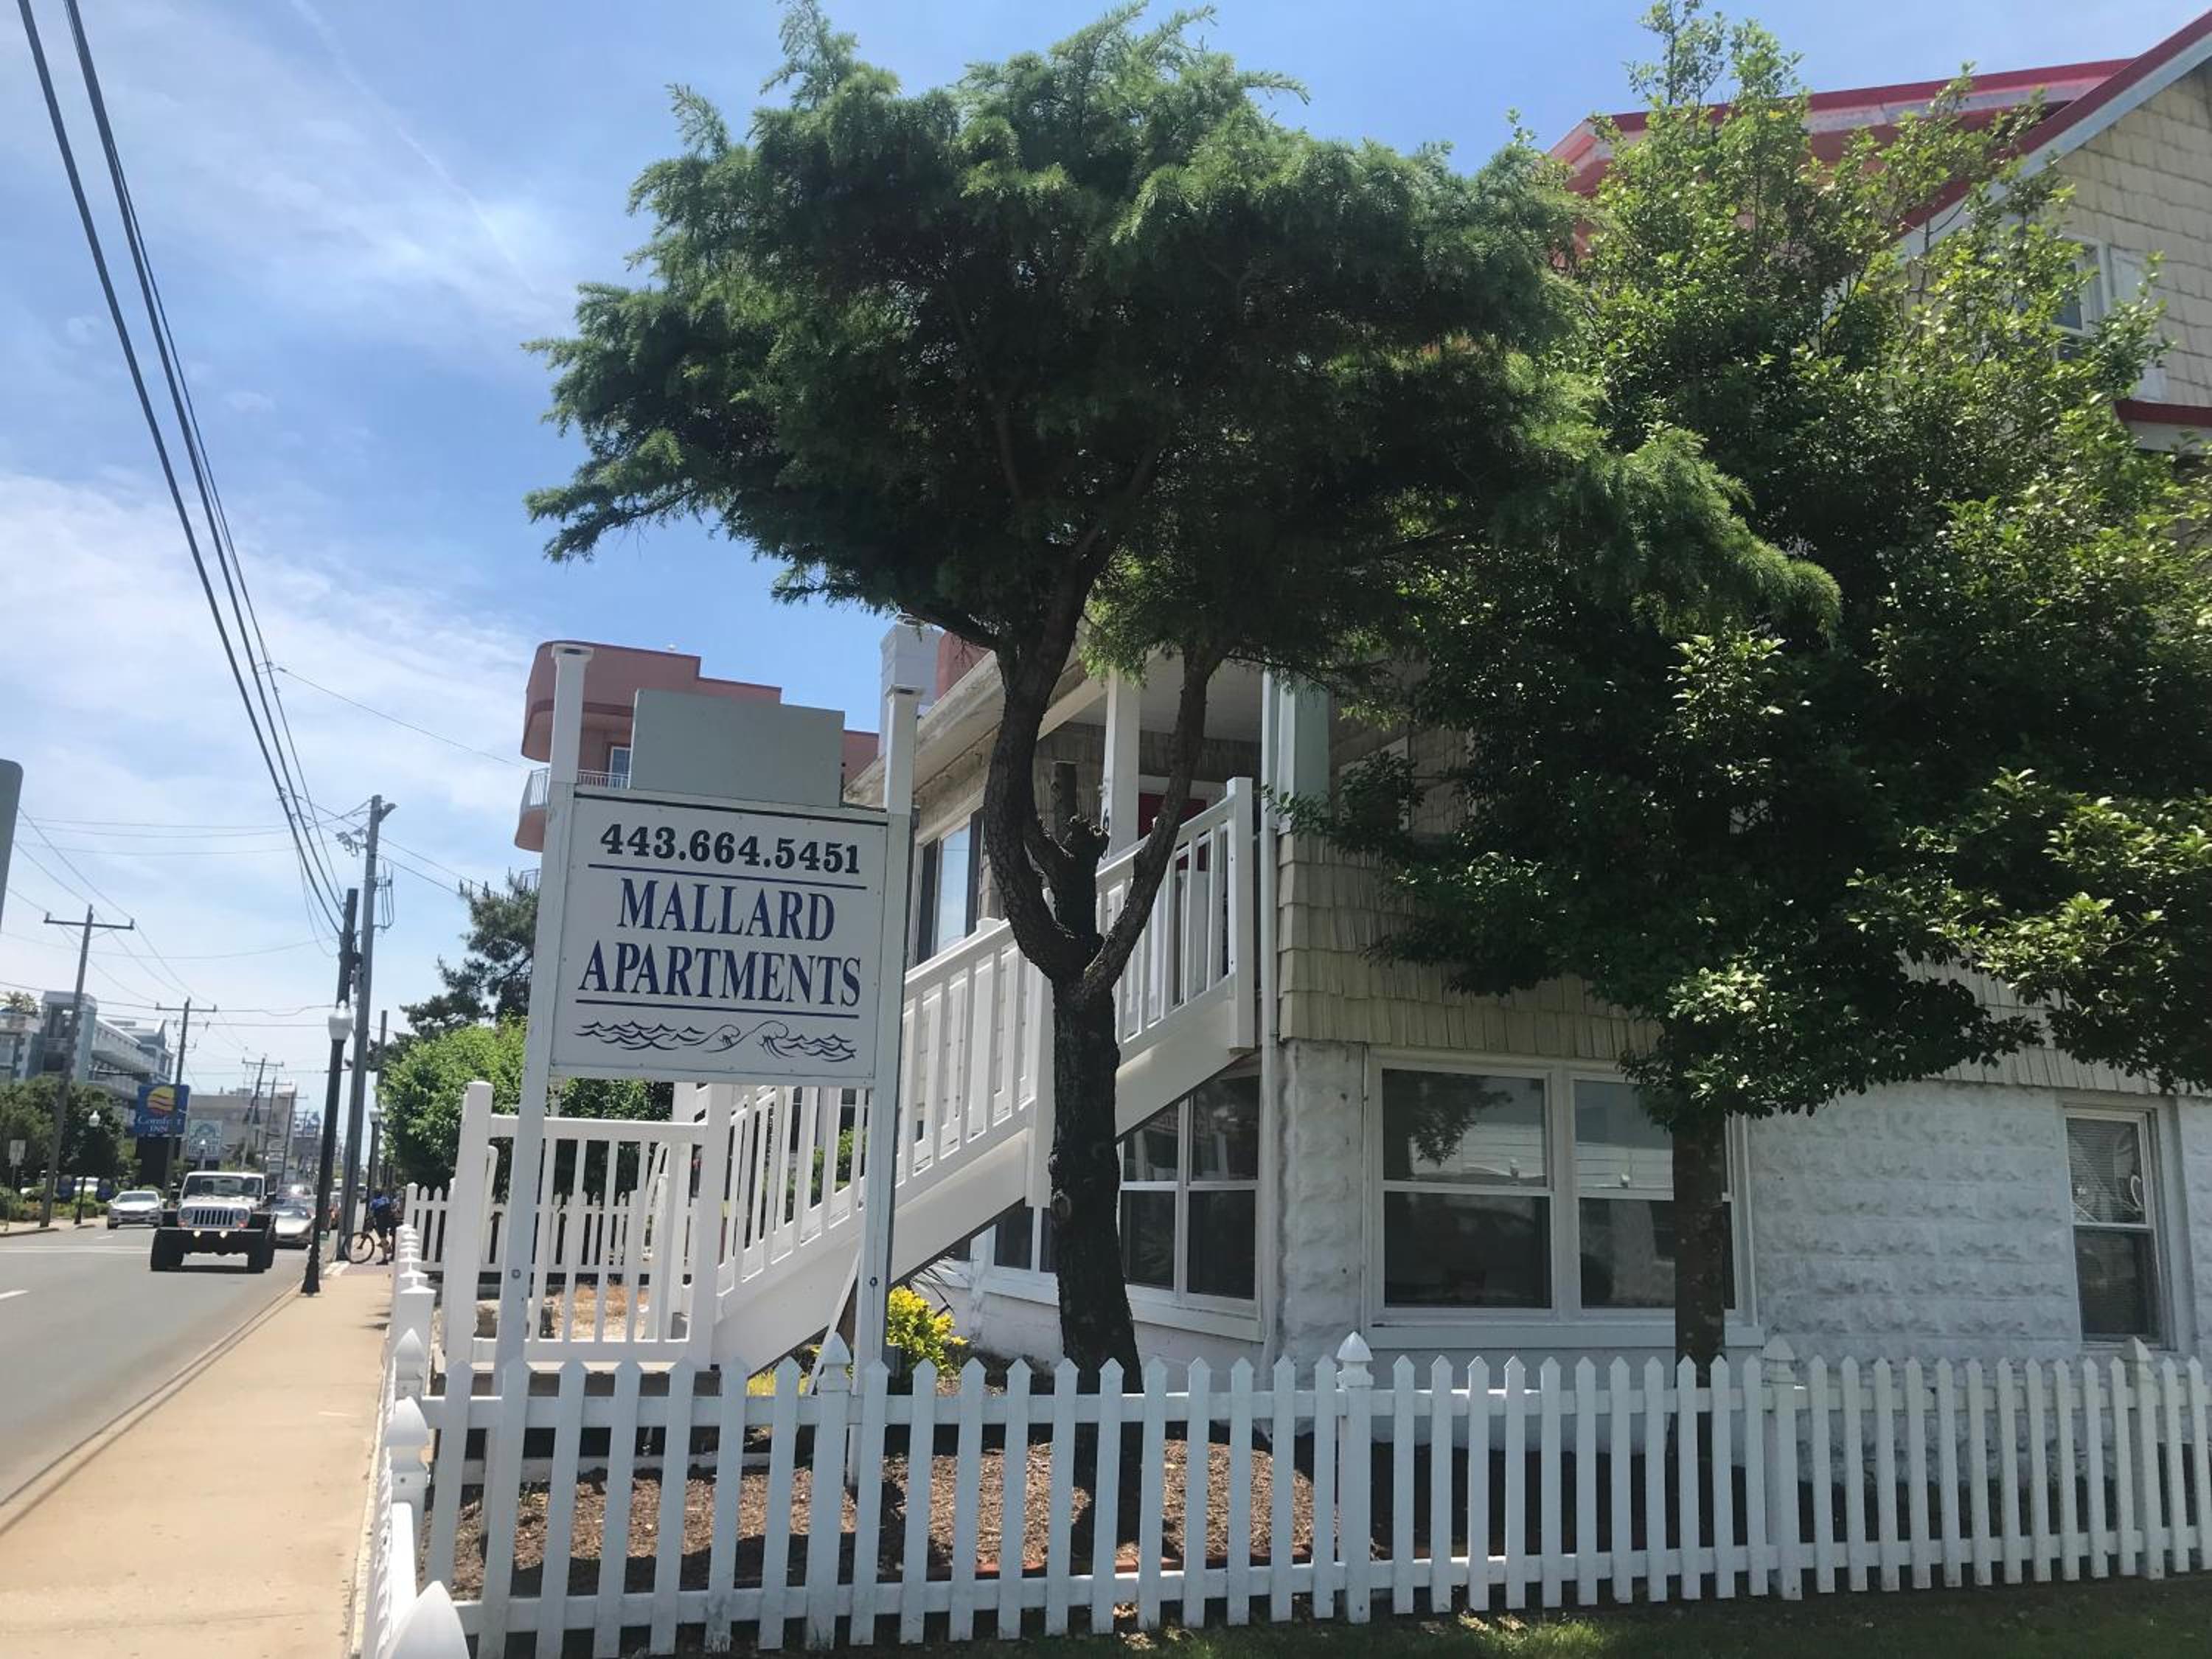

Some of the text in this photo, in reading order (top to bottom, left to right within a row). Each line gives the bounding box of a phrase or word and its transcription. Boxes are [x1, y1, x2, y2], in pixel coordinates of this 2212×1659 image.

[601, 824, 860, 874] 443.664.5451
[617, 878, 835, 941] MALLARD
[578, 940, 861, 1007] APARTMENTS
